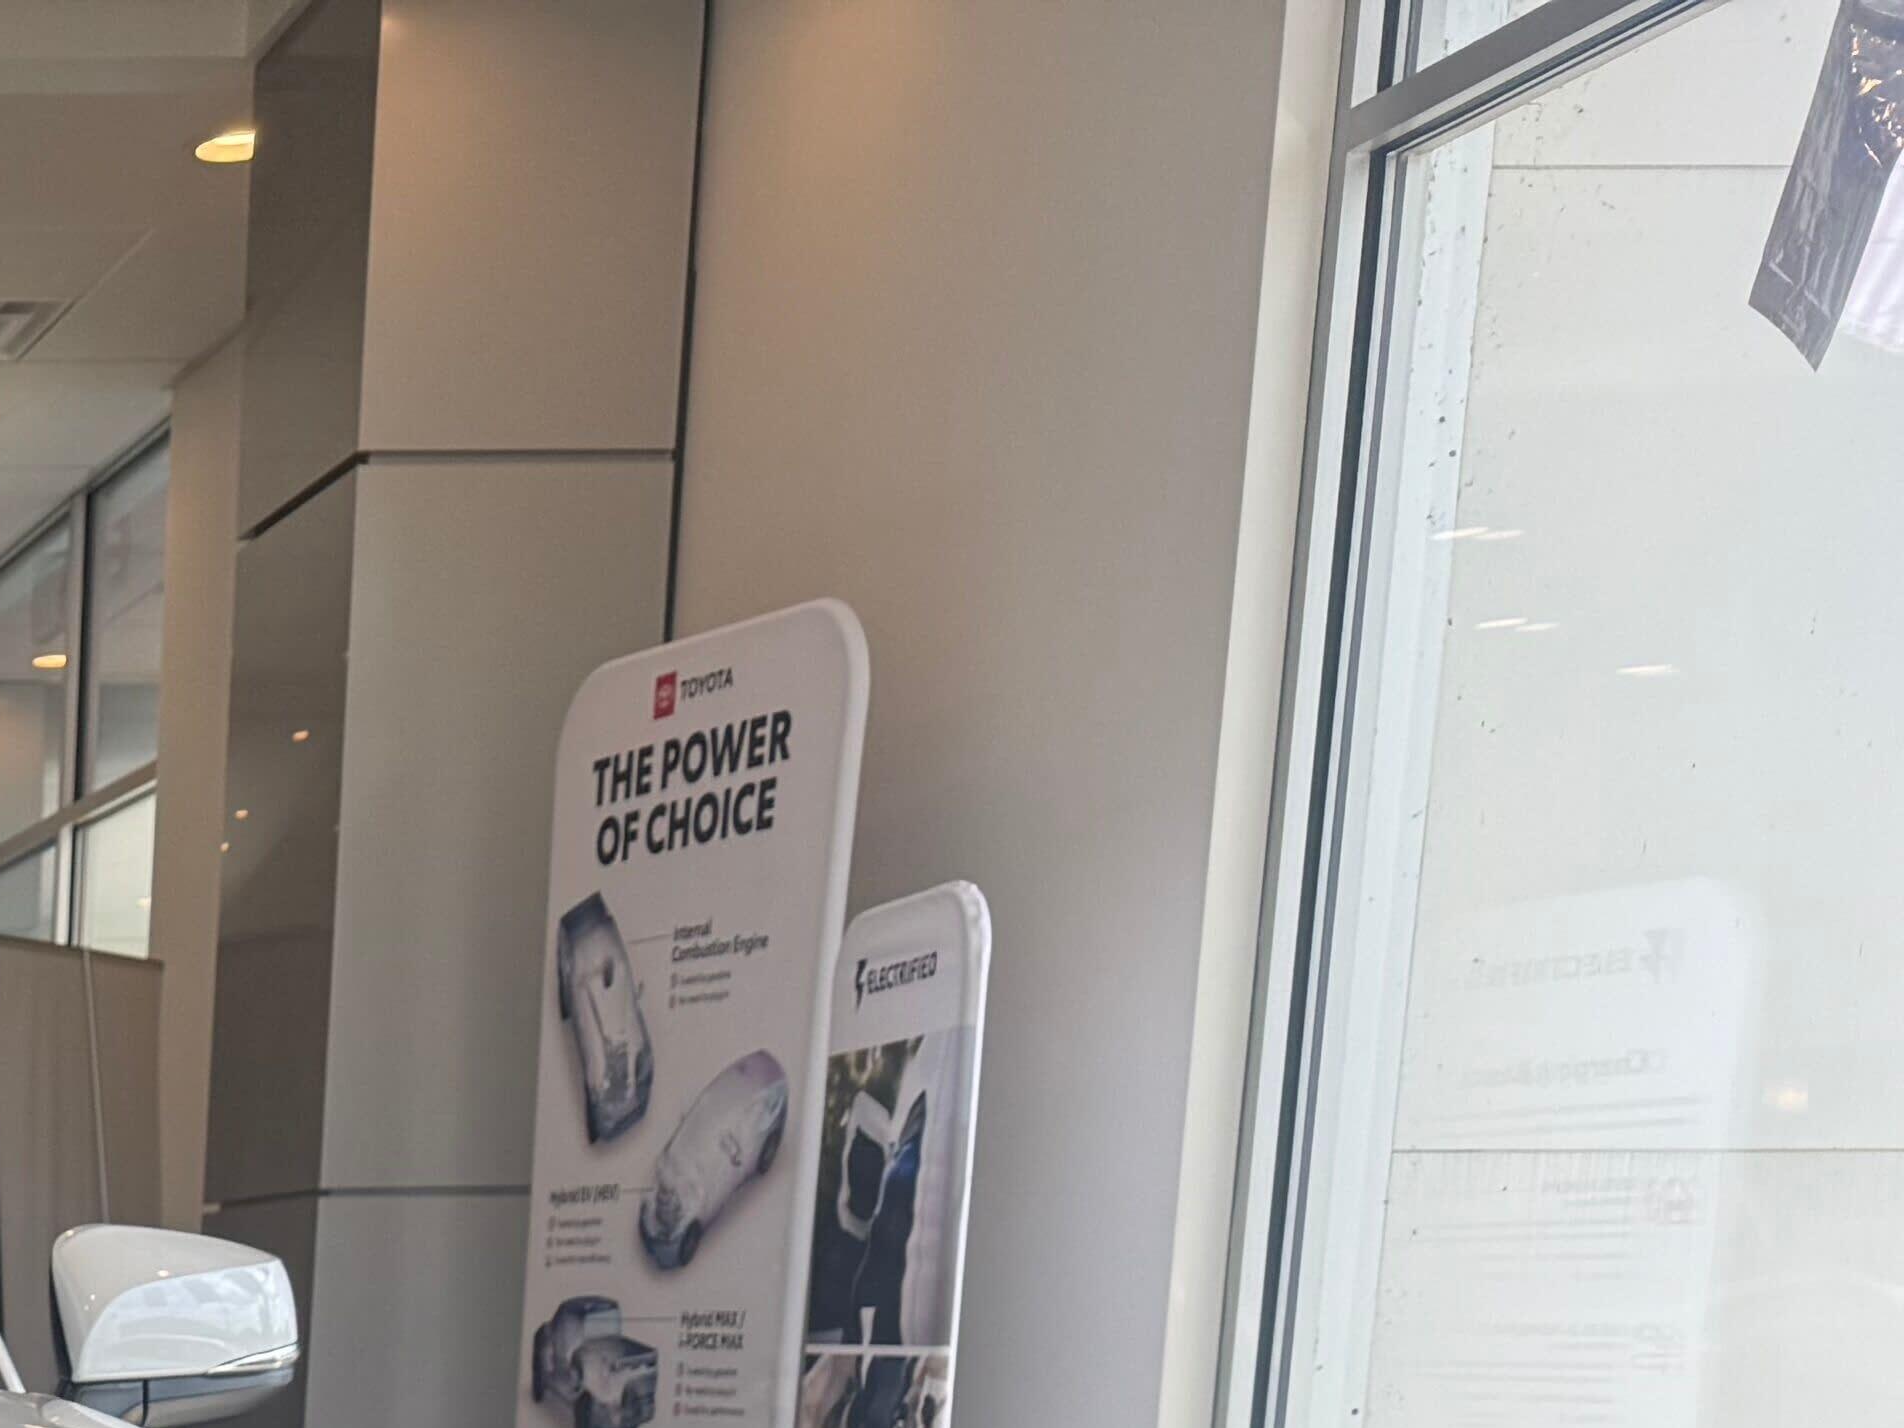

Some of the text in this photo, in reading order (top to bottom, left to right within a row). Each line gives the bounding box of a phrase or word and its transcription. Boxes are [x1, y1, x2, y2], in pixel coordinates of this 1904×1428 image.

[680, 668, 733, 700] TOYOTA
[593, 710, 792, 806] THE POWER
[597, 776, 777, 866] OF CHOICE
[672, 934, 769, 961] Combustion Engine
[867, 951, 938, 994] ELECTRIFIED
[720, 1333, 743, 1350] MAX
